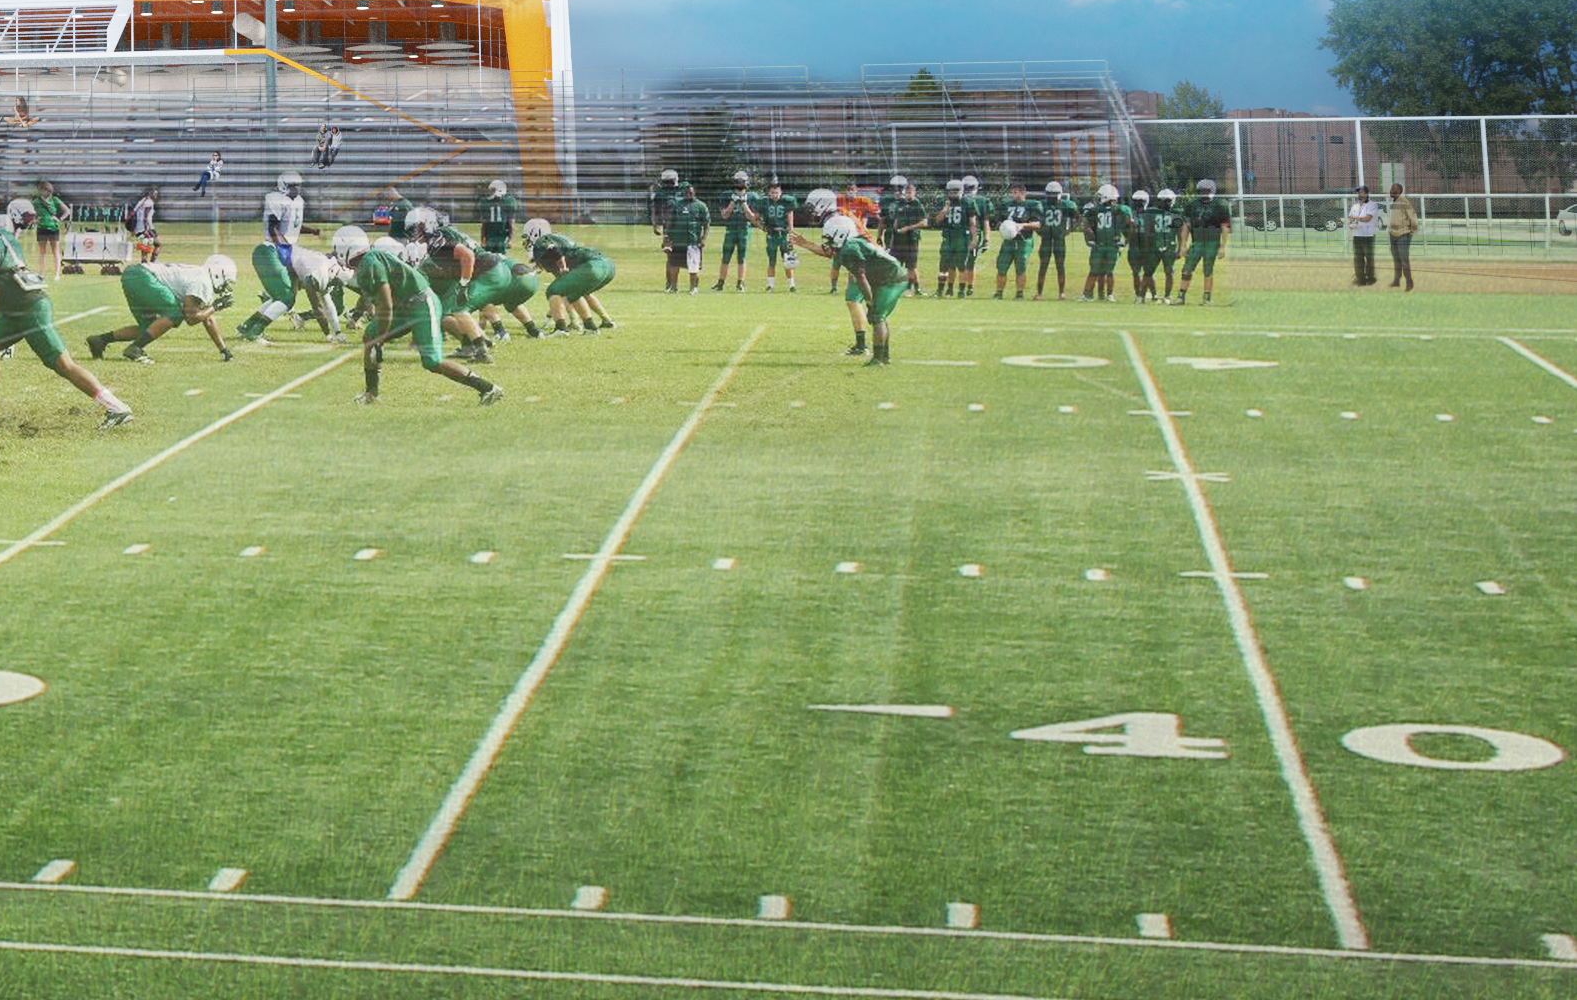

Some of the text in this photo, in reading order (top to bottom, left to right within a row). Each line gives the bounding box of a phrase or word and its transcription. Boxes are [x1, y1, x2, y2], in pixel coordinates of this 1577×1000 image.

[490, 206, 502, 222] 11
[1045, 209, 1062, 227] 23
[1097, 212, 1112, 229] 30
